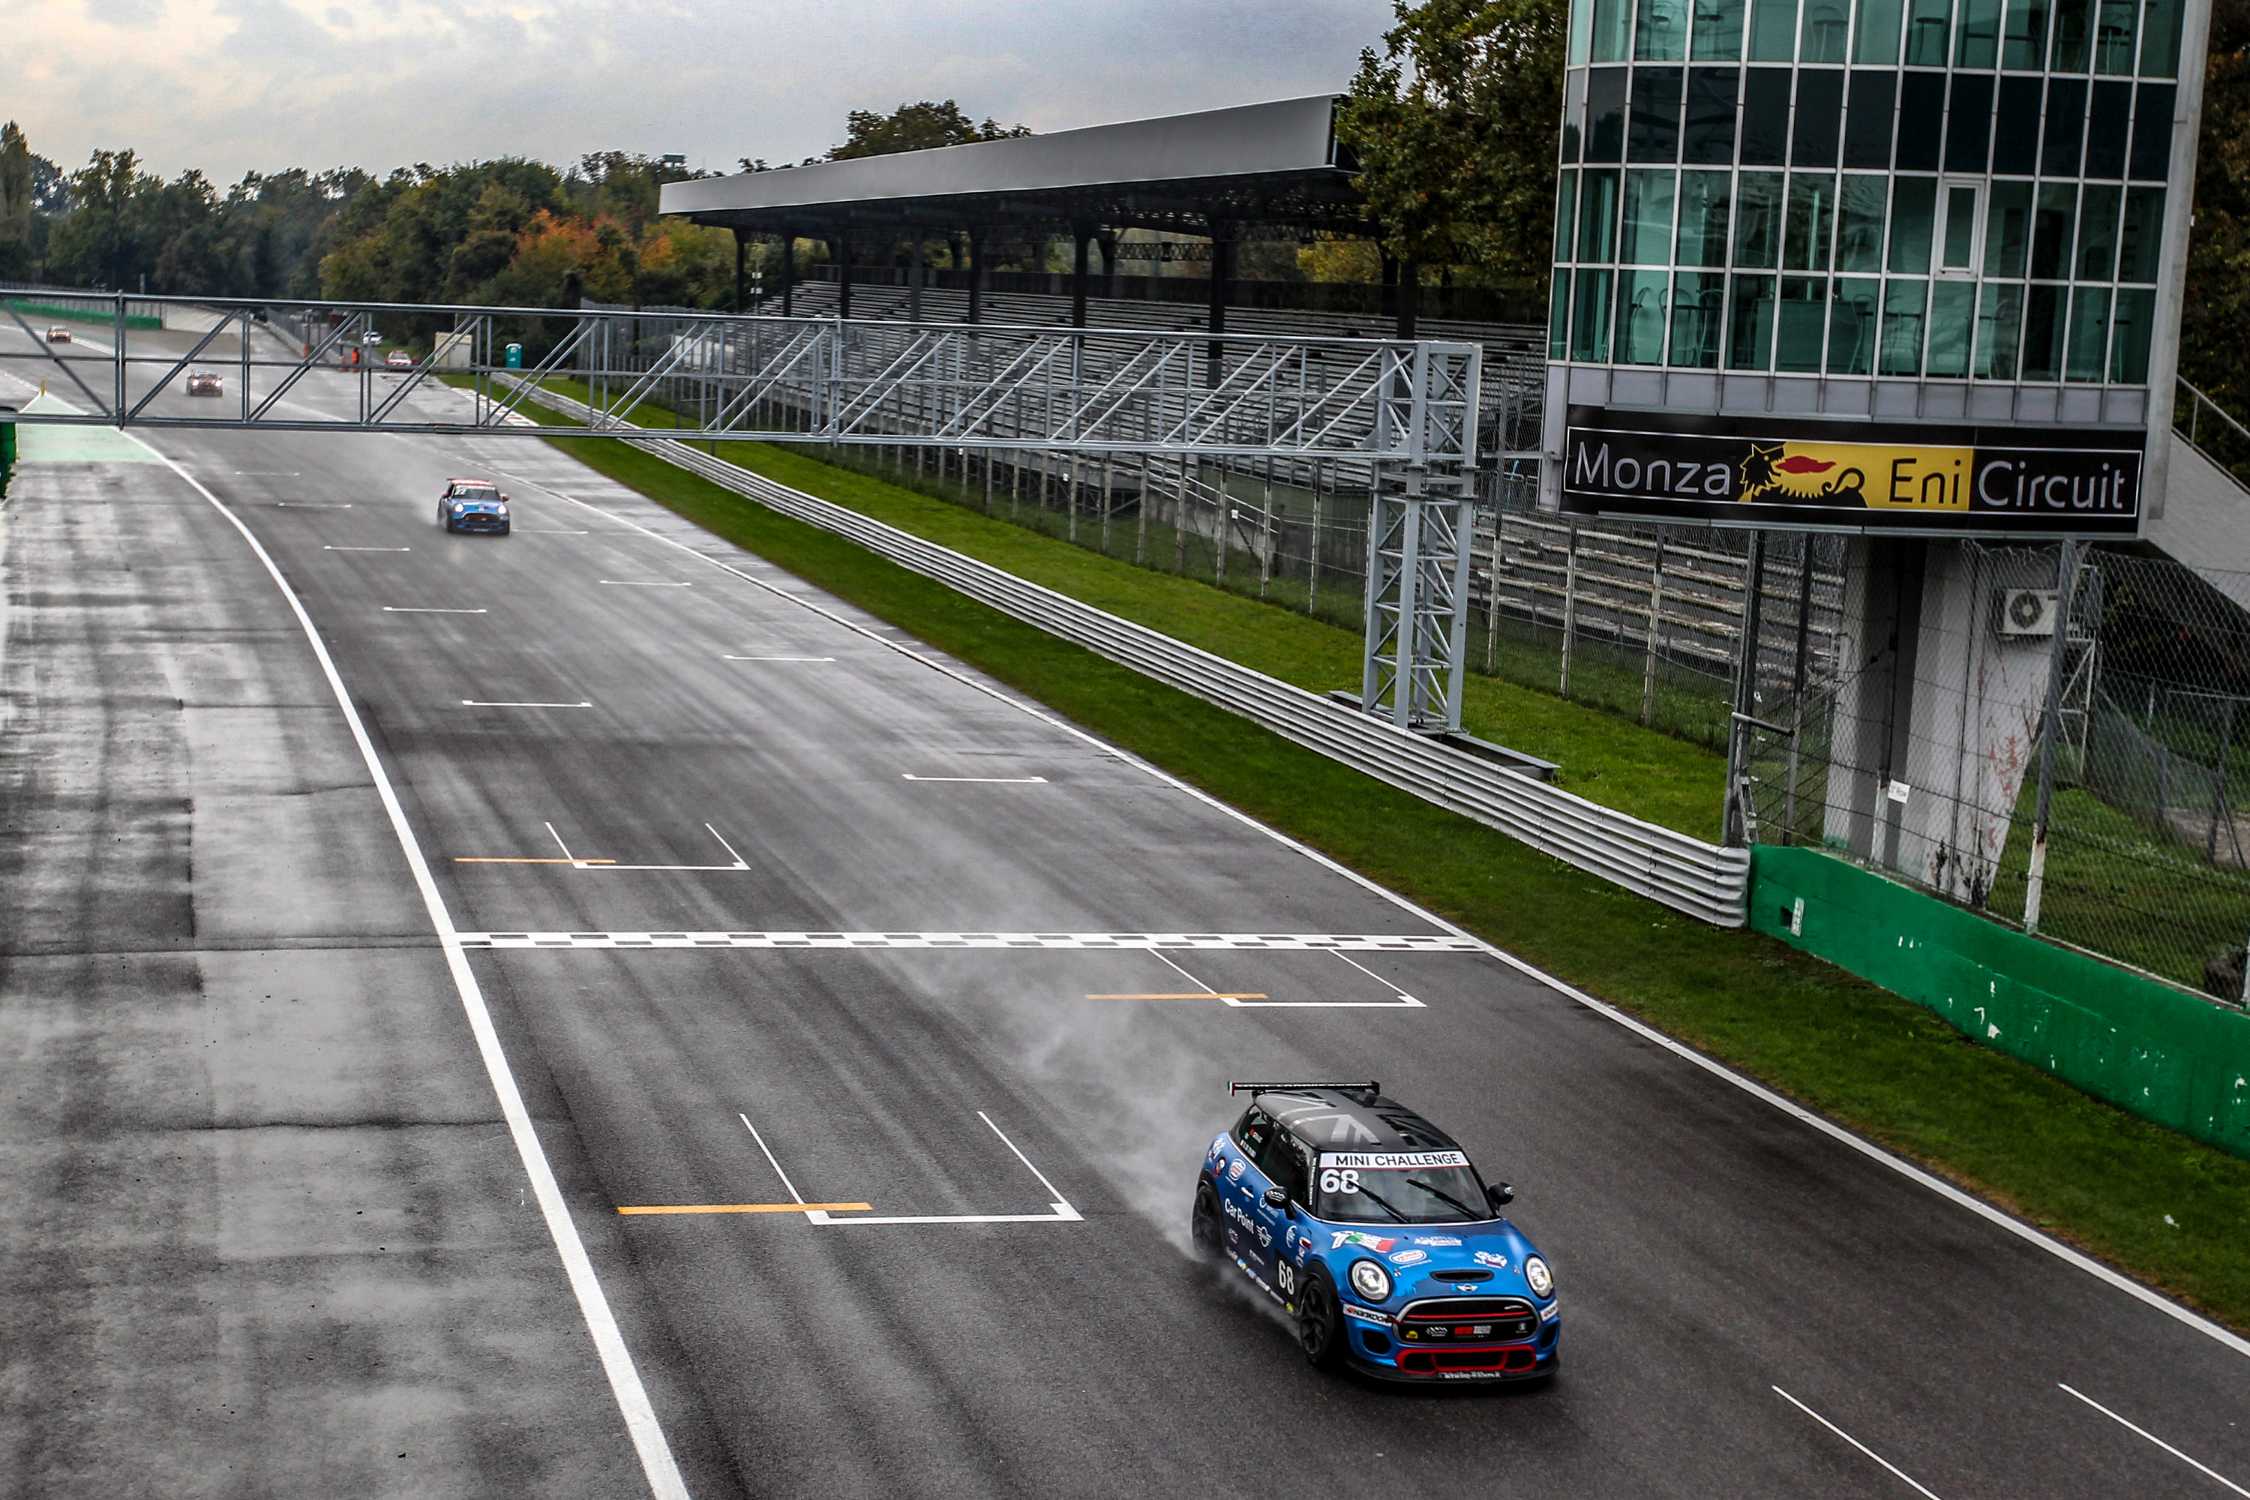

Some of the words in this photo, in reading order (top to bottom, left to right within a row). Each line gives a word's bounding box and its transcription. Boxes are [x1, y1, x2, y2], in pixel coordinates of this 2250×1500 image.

[1574, 440, 1732, 496] Monza
[1888, 457, 1961, 506] Eni
[1977, 460, 2126, 510] Circuit
[1335, 1154, 1370, 1167] MINI
[1374, 1153, 1461, 1167] CHALLENGE
[1319, 1168, 1360, 1195] 68
[1278, 1259, 1295, 1295] 68
